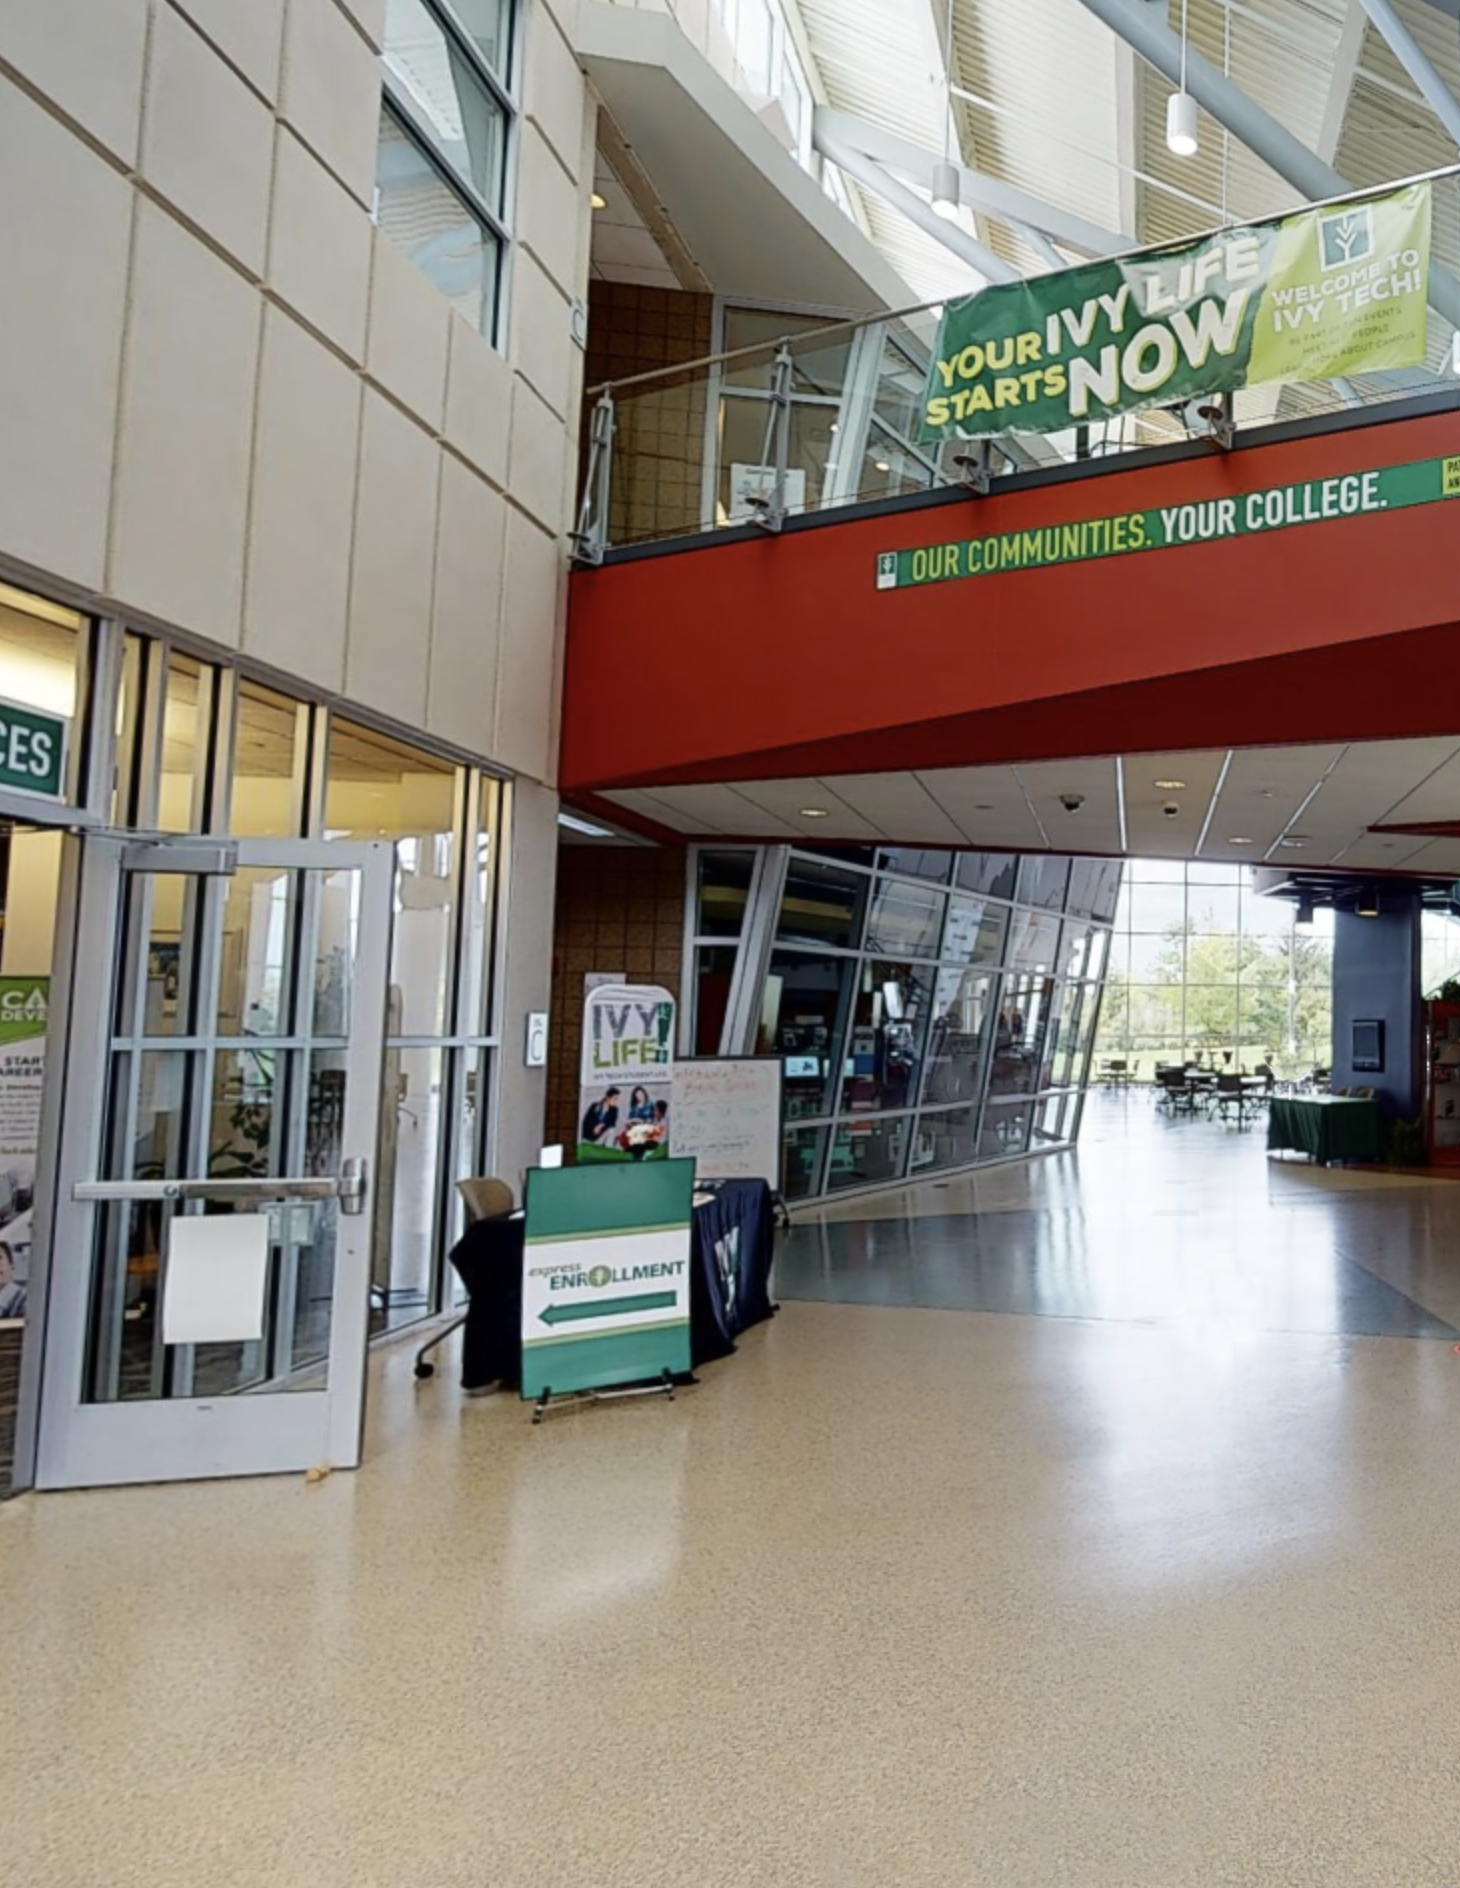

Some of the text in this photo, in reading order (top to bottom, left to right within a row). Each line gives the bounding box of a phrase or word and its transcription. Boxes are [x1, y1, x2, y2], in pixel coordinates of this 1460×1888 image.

[1271, 249, 1420, 307] WELCOME TO
[1272, 269, 1422, 333] IVY TECH!
[936, 236, 1261, 388] YOUR IVY LIFE
[925, 288, 1249, 426] STARTS NOW
[1340, 341, 1373, 357] ABOUT
[1375, 330, 1416, 350] CAMPUS
[911, 471, 1389, 583] OUR COMMUNITIES. YOUR COLLEGE.
[593, 1003, 660, 1040] IVY
[528, 1261, 583, 1279] express
